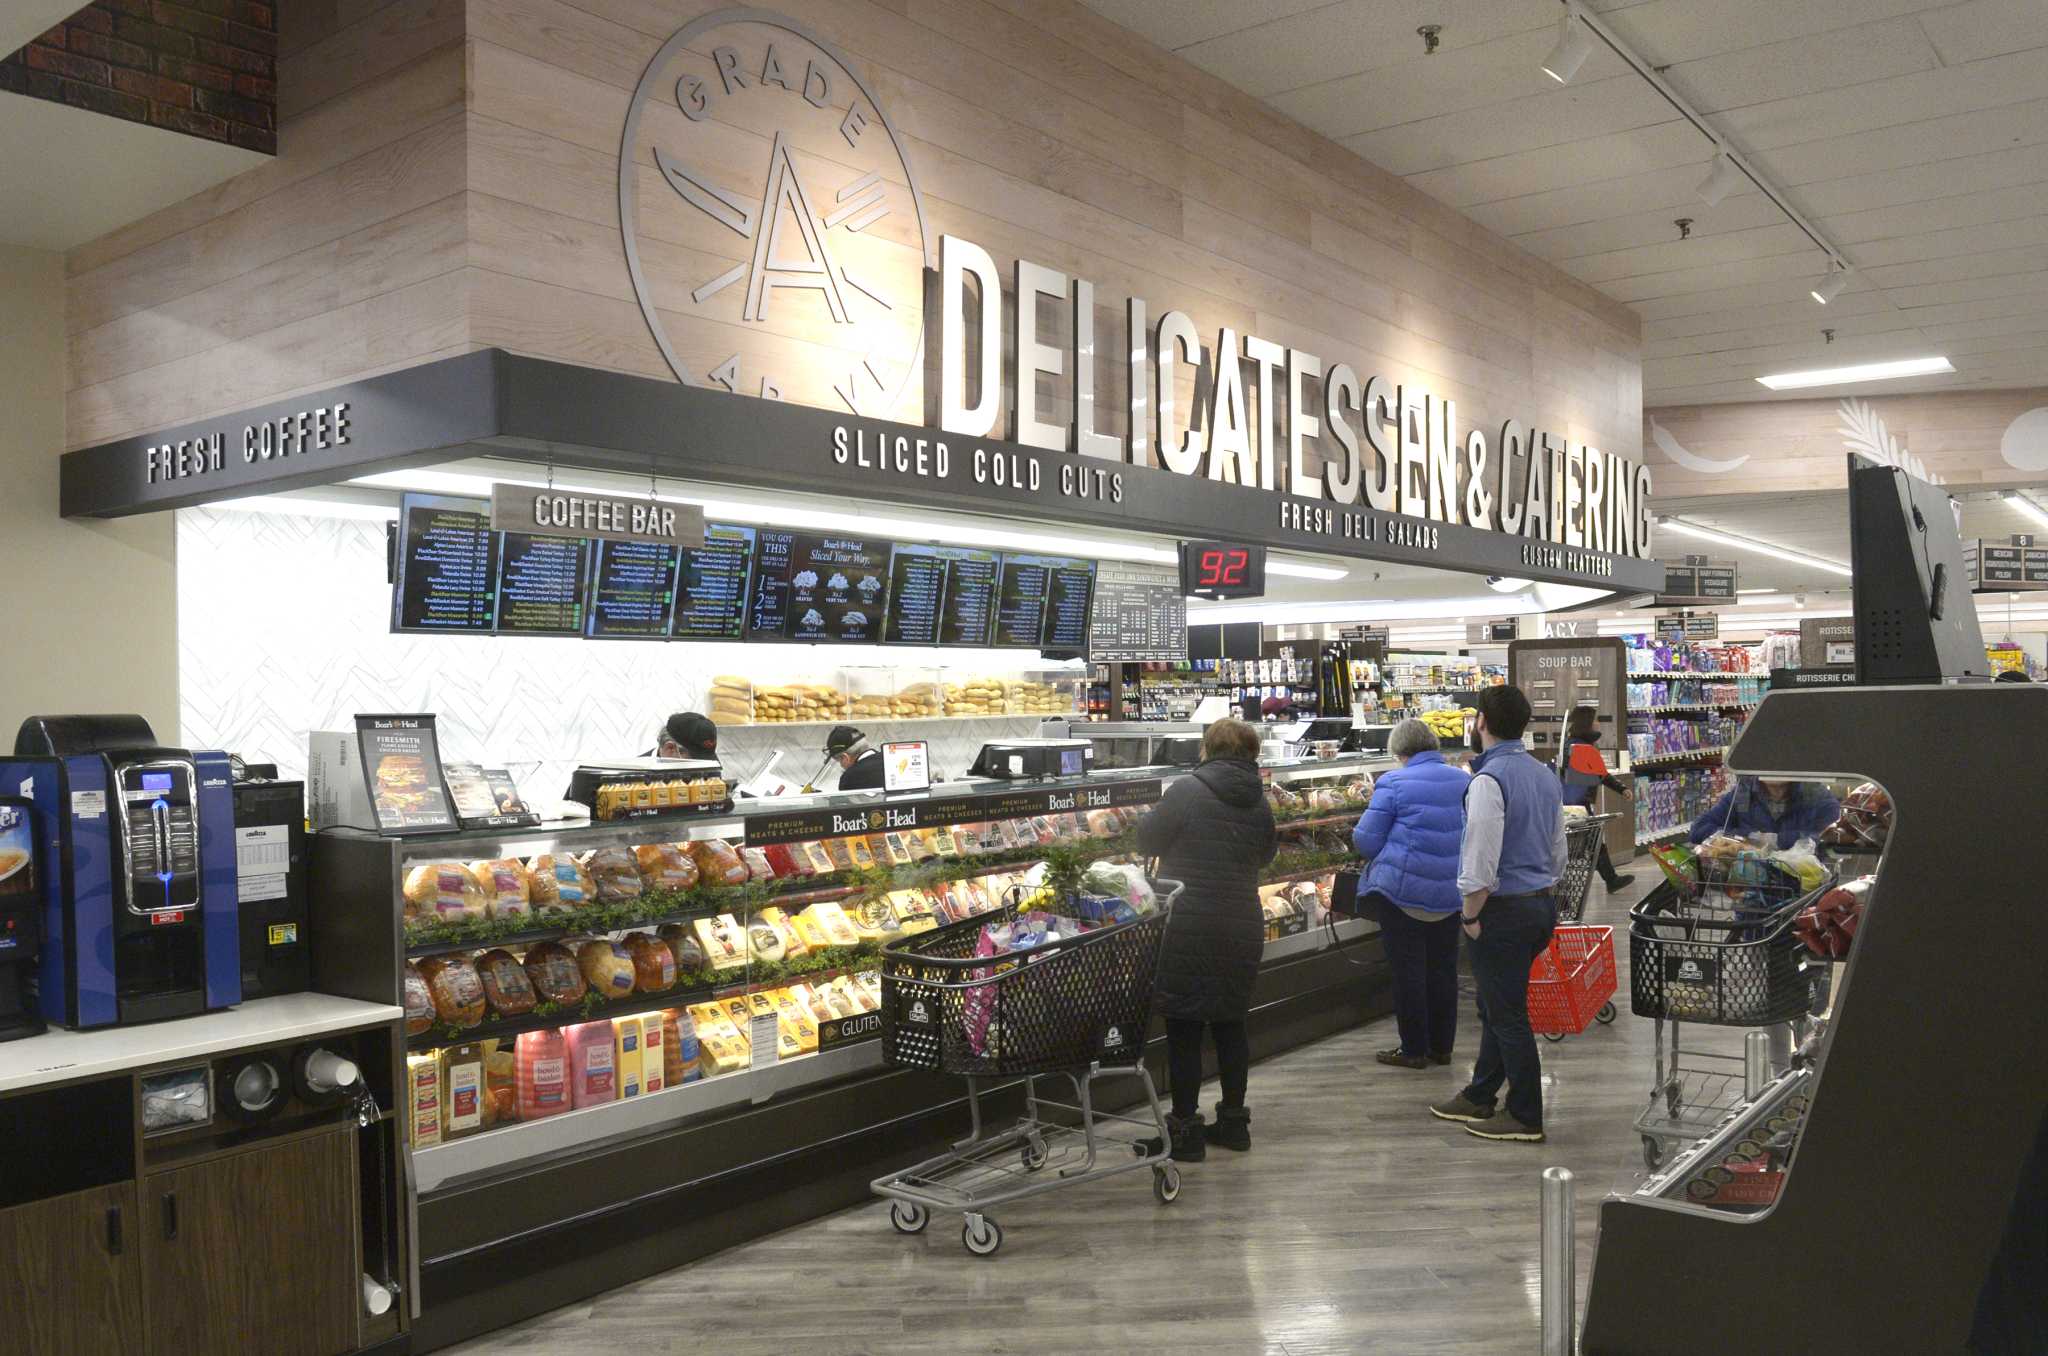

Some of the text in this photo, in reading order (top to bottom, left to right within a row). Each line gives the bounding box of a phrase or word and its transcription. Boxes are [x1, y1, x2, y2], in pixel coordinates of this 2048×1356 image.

[675, 43, 867, 148] GRADE
[939, 234, 1457, 525] DELICATESSEN
[1466, 430, 1493, 530] &
[1500, 419, 1653, 560] CATERING
[147, 403, 347, 484] FRESH COFFEE
[832, 426, 1122, 503] SLICED COLD CUTS
[535, 495, 676, 537] COFFEE BAR
[1281, 501, 1438, 550] FRESH DELI SALADS
[765, 543, 788, 554] THIS
[810, 549, 833, 561] Sliced
[1523, 544, 1612, 577] CUSTOM PLATTERS
[1695, 556, 1700, 565] 7
[1200, 551, 1248, 584] 92
[1539, 655, 1592, 668] SOUP BAR
[1796, 673, 1856, 682] ROTISSERIE CHI
[401, 720, 418, 728] Head
[1048, 791, 1075, 810] Boar's
[1088, 788, 1111, 806] Head
[768, 820, 804, 829] PREMIUM
[833, 807, 916, 833] Boar's Head
